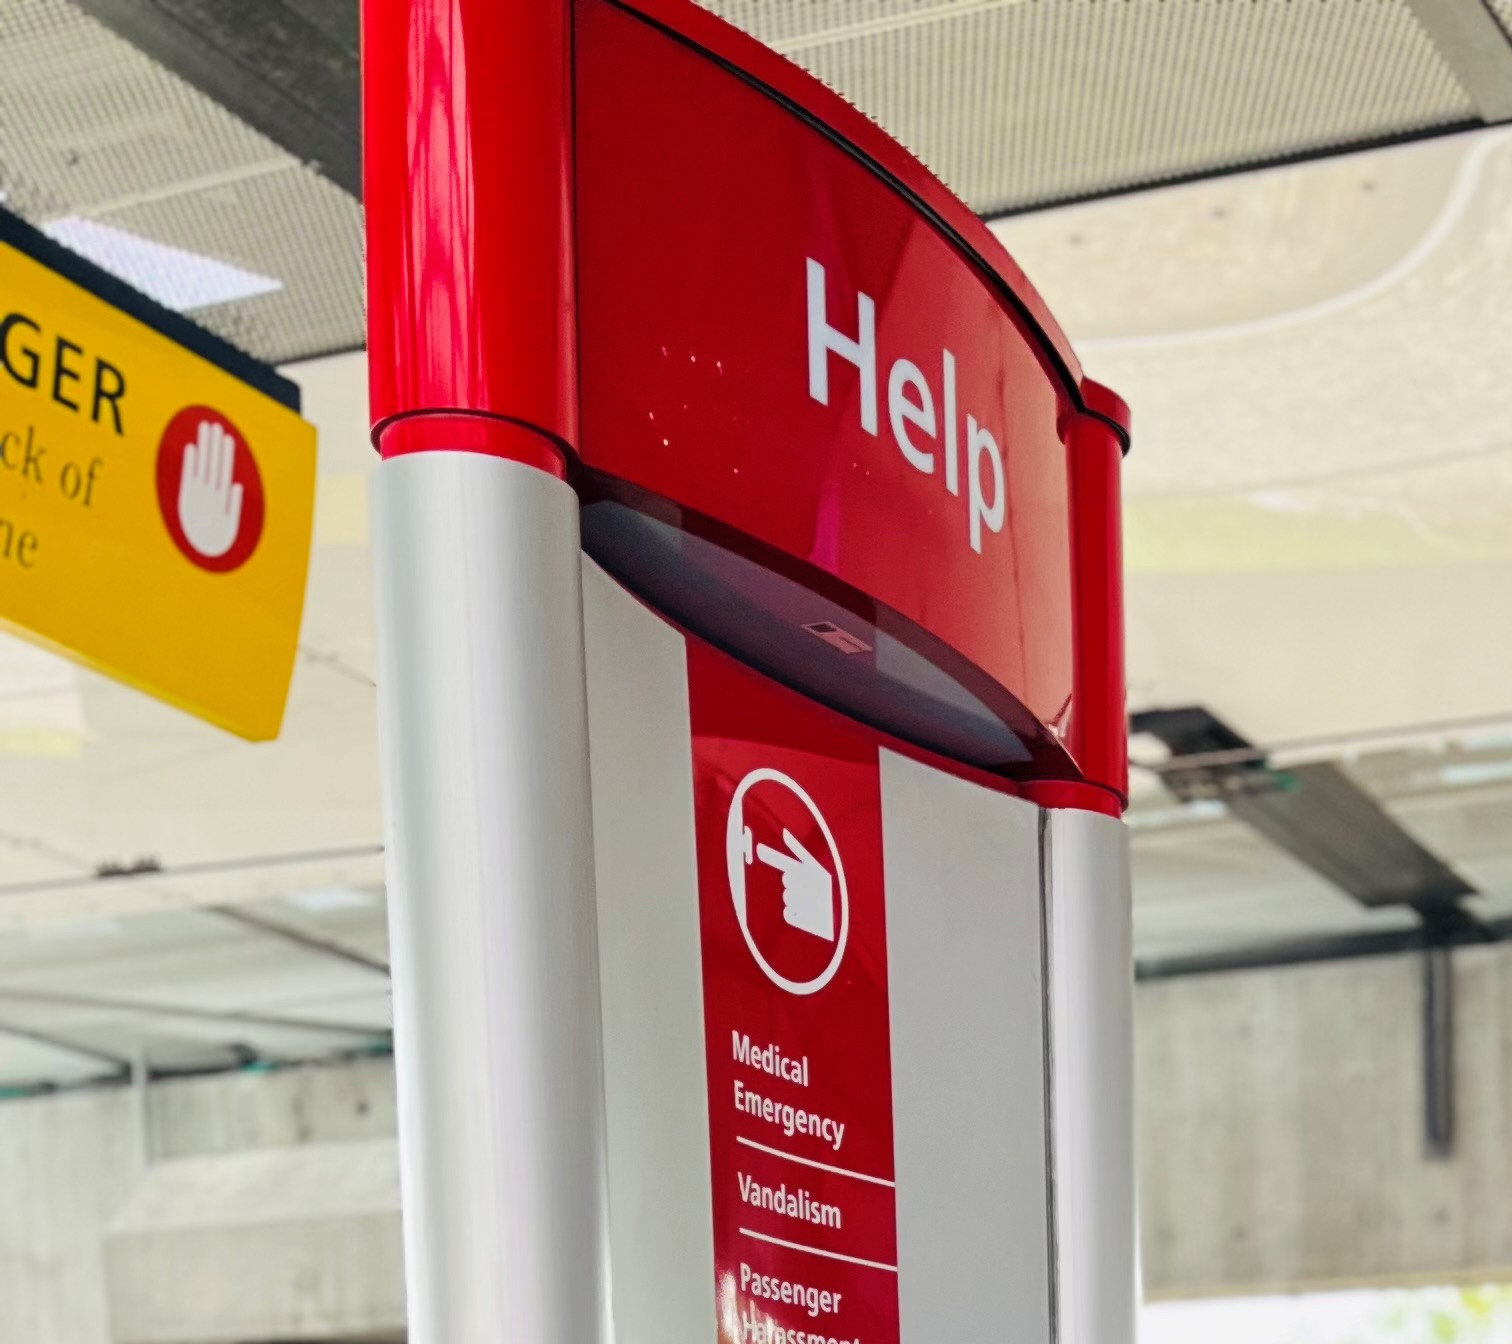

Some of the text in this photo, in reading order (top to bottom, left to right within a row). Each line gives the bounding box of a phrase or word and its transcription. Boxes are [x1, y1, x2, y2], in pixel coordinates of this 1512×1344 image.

[807, 256, 1005, 555] Help
[59, 456, 103, 507] of
[731, 1029, 809, 1088] Medical
[733, 1080, 846, 1150] Emergency
[737, 1172, 842, 1229] Vandalism
[739, 1263, 843, 1318] Passenger
